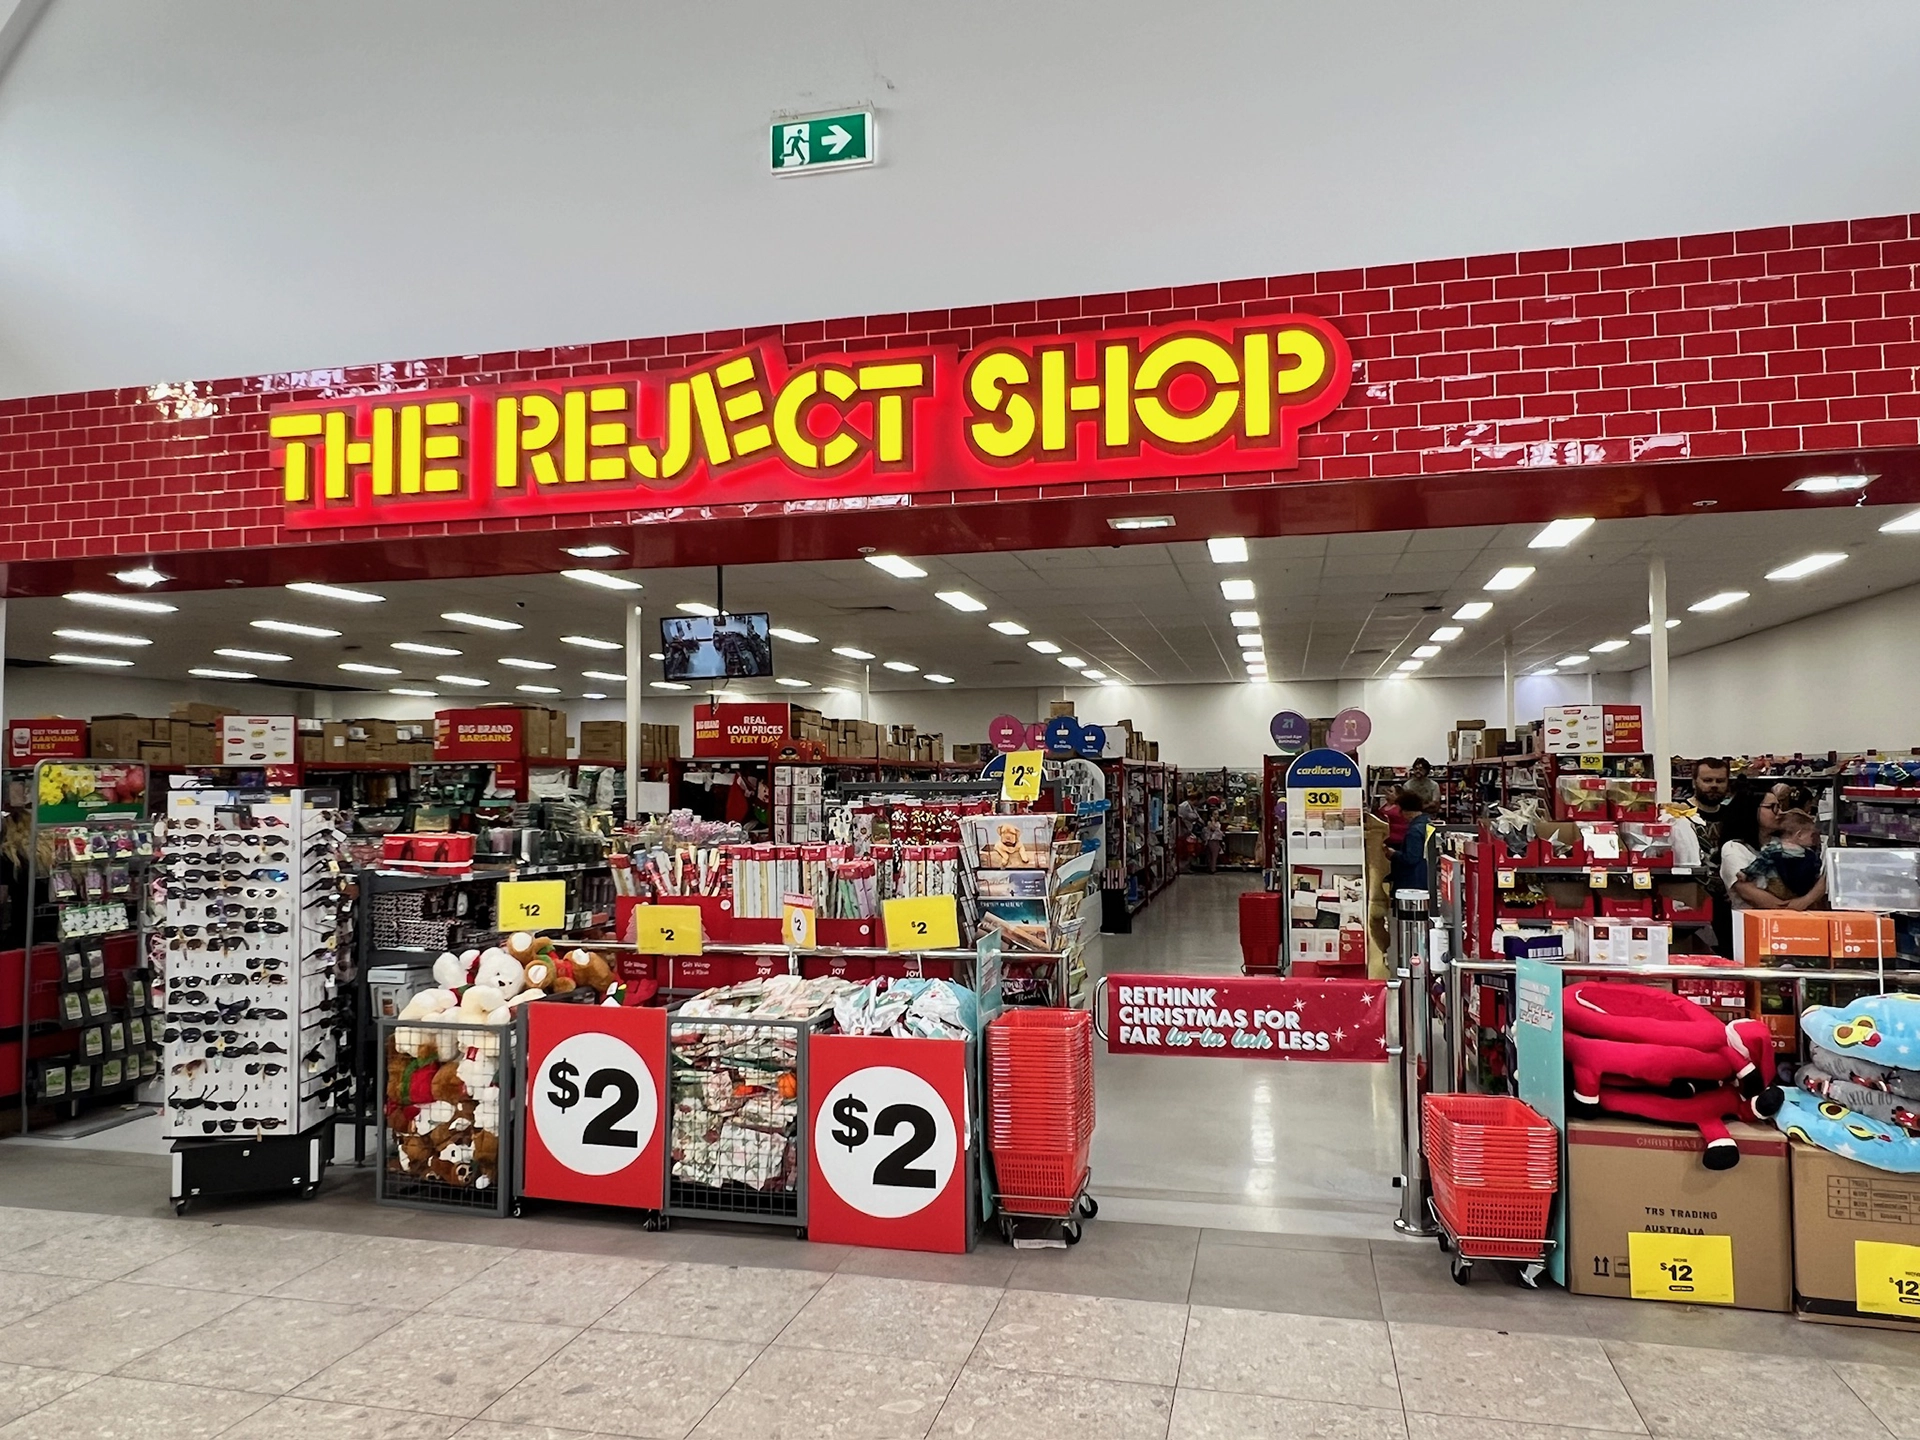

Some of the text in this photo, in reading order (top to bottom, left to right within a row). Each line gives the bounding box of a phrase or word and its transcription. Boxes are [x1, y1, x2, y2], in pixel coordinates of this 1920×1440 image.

[270, 329, 1326, 501] THE REJECT SHOP
[743, 716, 767, 725] REAL
[458, 724, 514, 734] BIG BRAND
[727, 725, 784, 735] LOW PRICES
[459, 734, 512, 742] BARGAINS
[730, 735, 781, 744] EVERY DAY
[1296, 765, 1352, 777] cardfactory
[519, 903, 540, 917] $12
[660, 928, 675, 941] $2
[911, 921, 928, 935] $2
[757, 967, 772, 976] JOY
[831, 967, 846, 976] JOY
[906, 970, 920, 978] JOY
[1118, 985, 1218, 1008] RETHINK
[1118, 1006, 1300, 1031] CHRISTMAS FOR
[1119, 1026, 1162, 1046] FAR
[1278, 1030, 1331, 1051] LESS
[547, 1057, 640, 1149] $2
[831, 1093, 937, 1190] $2
[1636, 1137, 1698, 1149] CHRISTMAS
[1644, 1206, 1718, 1220] TRS TRADING
[1644, 1224, 1705, 1236] AUSTRALIA
[1660, 1262, 1693, 1282] $12
[1888, 1276, 1919, 1297] $12
